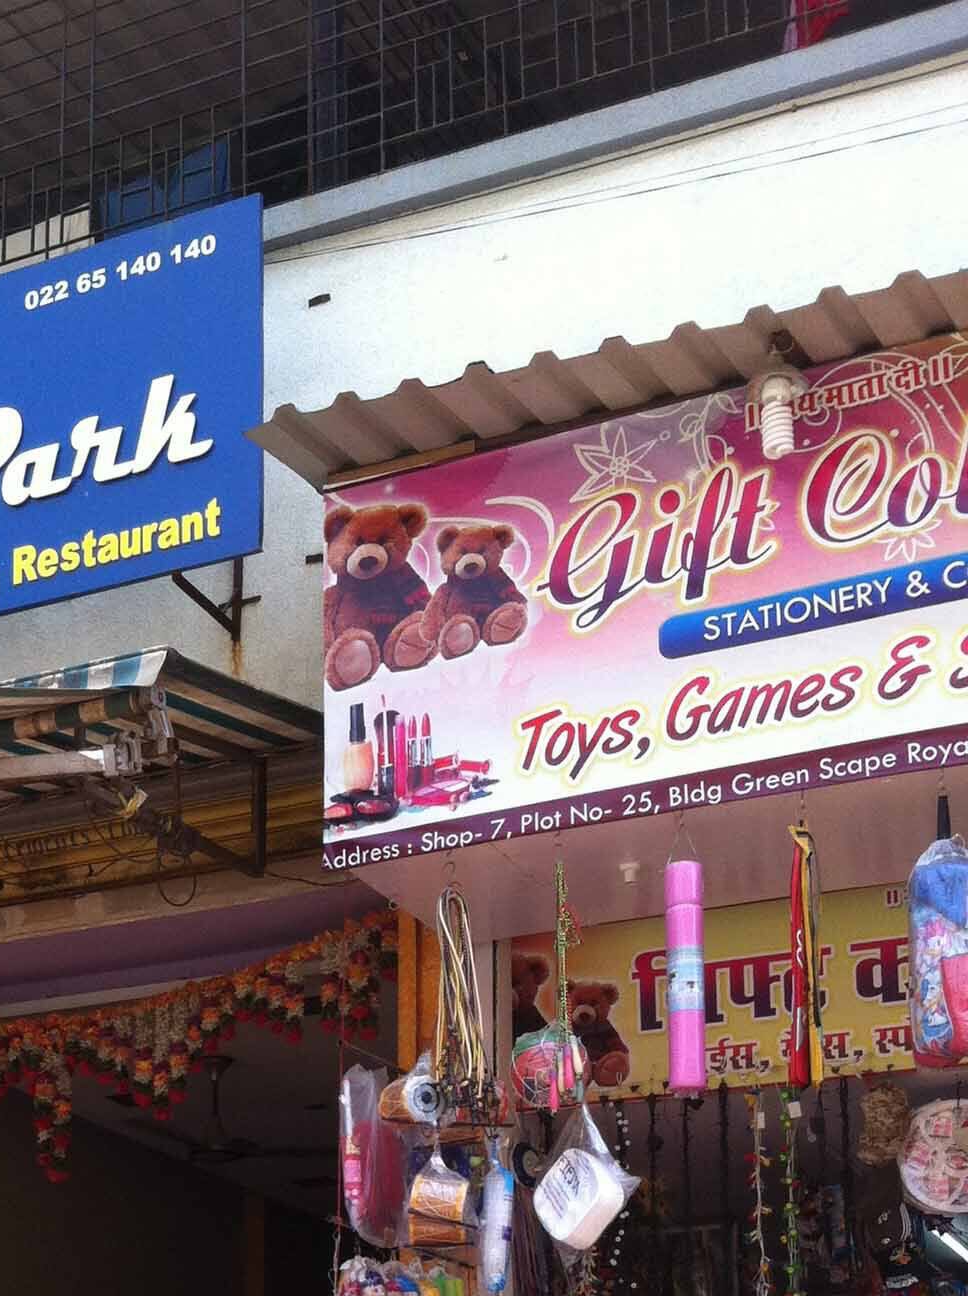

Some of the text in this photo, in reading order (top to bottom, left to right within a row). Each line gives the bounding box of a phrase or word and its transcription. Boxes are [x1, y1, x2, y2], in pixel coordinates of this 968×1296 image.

[23, 233, 218, 311] 022 65 140 140
[12, 497, 222, 586] Restaurant
[536, 463, 778, 628] Gift
[703, 576, 892, 641] STATIONERY
[905, 570, 931, 597] &
[520, 708, 651, 781] Toys,
[666, 664, 863, 742] Games
[878, 635, 932, 701] &
[321, 841, 401, 870] Address
[421, 830, 483, 857] Shop-
[490, 818, 512, 841] 7,
[521, 812, 561, 834] Plot
[571, 802, 612, 824] No-
[622, 790, 661, 815] 25,
[669, 783, 722, 807] Bldg
[732, 767, 810, 796] Green
[819, 752, 897, 781] Scape
